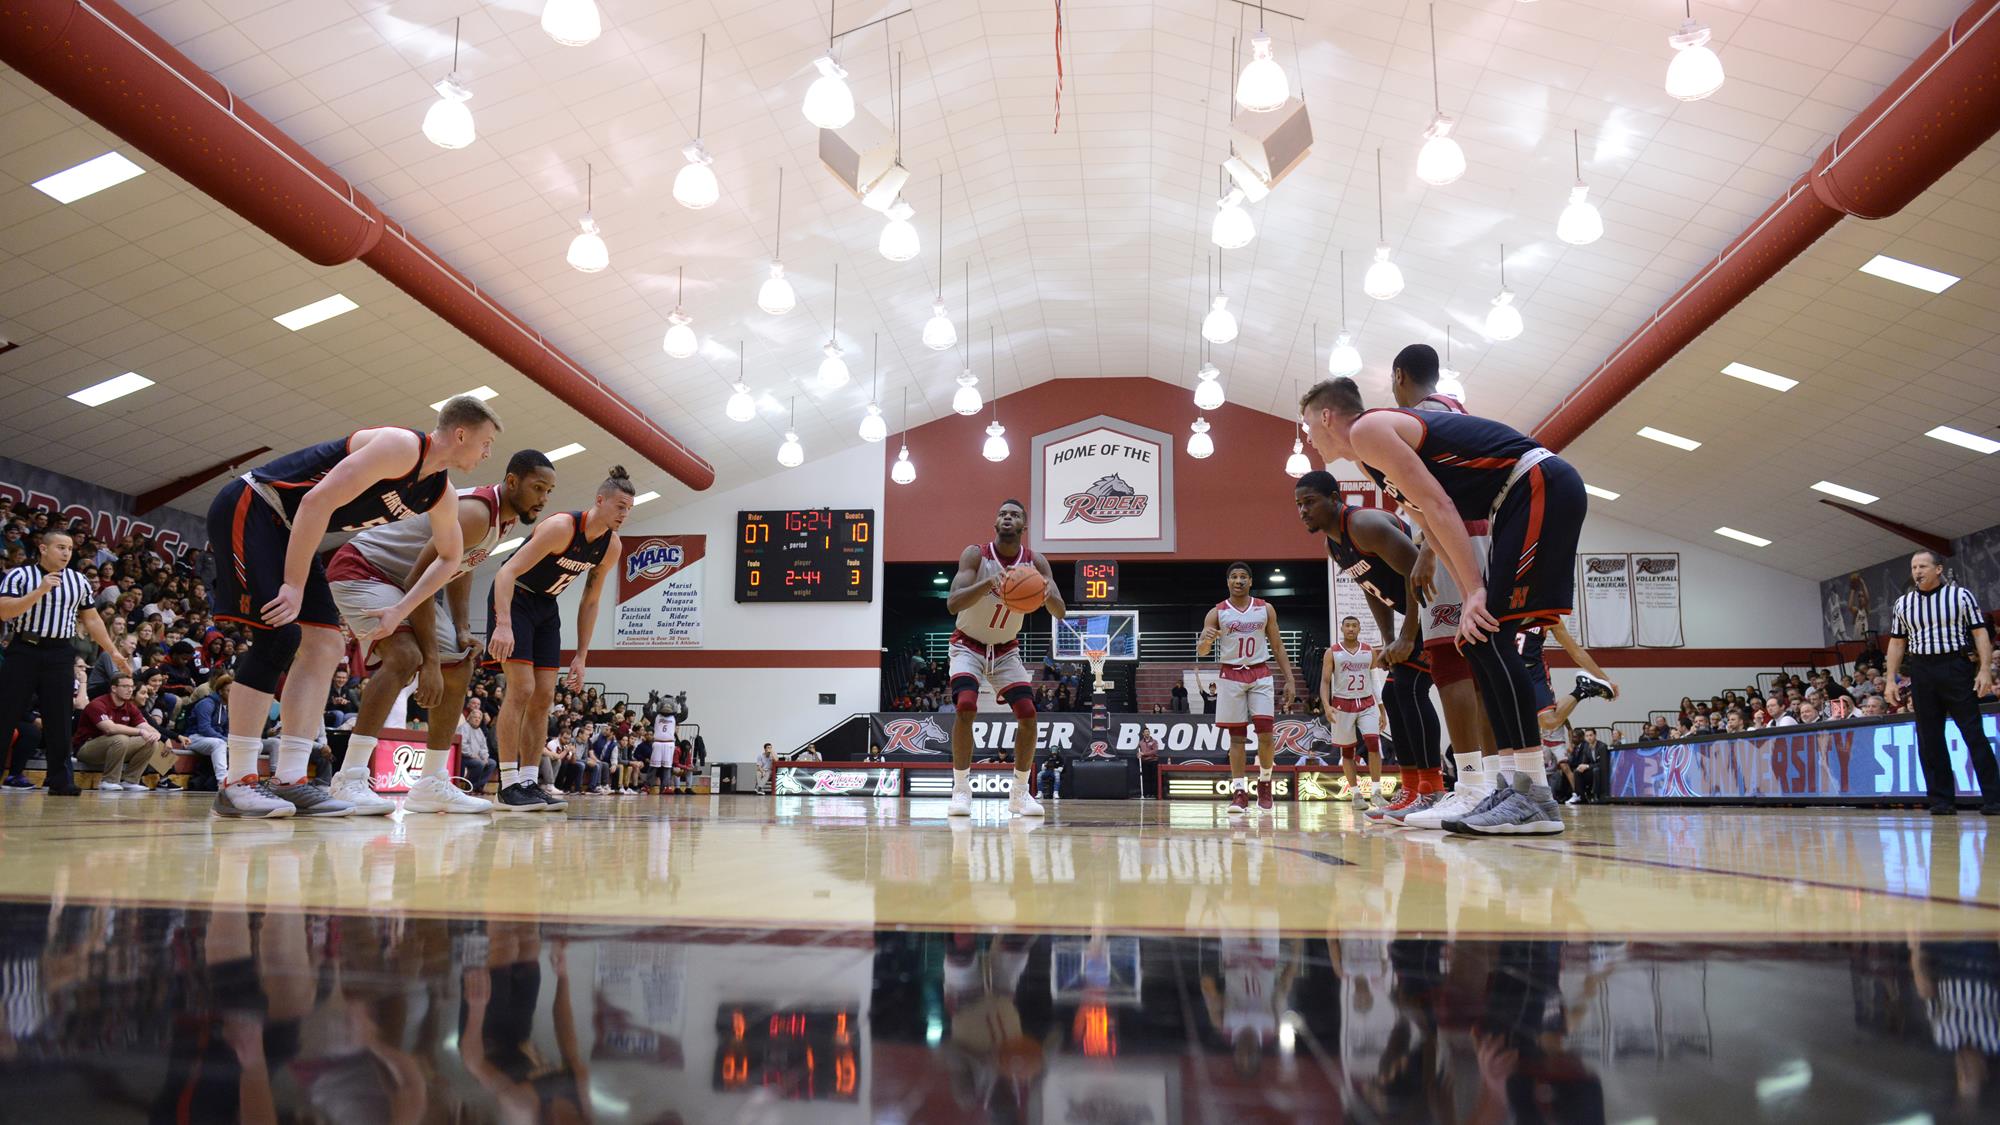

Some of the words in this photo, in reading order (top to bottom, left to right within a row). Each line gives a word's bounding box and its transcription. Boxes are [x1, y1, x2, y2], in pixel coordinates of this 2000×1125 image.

[1053, 444, 1097, 465] HOME
[1100, 444, 1120, 456] OF
[1123, 446, 1151, 463] THE
[1059, 492, 1148, 524] RIDER
[0, 481, 189, 566] RONCS'
[785, 511, 832, 531] 16:24
[745, 523, 769, 543] 07
[852, 522, 868, 542] 10
[789, 541, 807, 550] period
[627, 545, 683, 581] MAAC
[1083, 564, 1115, 578] 16:24
[751, 570, 760, 586] 0
[851, 569, 860, 585] 3
[1086, 580, 1107, 599] 30
[661, 605, 697, 613] Quinnipiac
[666, 598, 694, 606] Niagara
[989, 603, 1011, 629] 11
[1238, 637, 1256, 659] 10
[1347, 674, 1365, 691] 23
[662, 725, 668, 733] 6
[972, 721, 1075, 750] RIDER
[1873, 716, 1998, 793] STR
[391, 744, 427, 787] RID
[968, 774, 1013, 793] dida
[1215, 776, 1289, 796] aids
